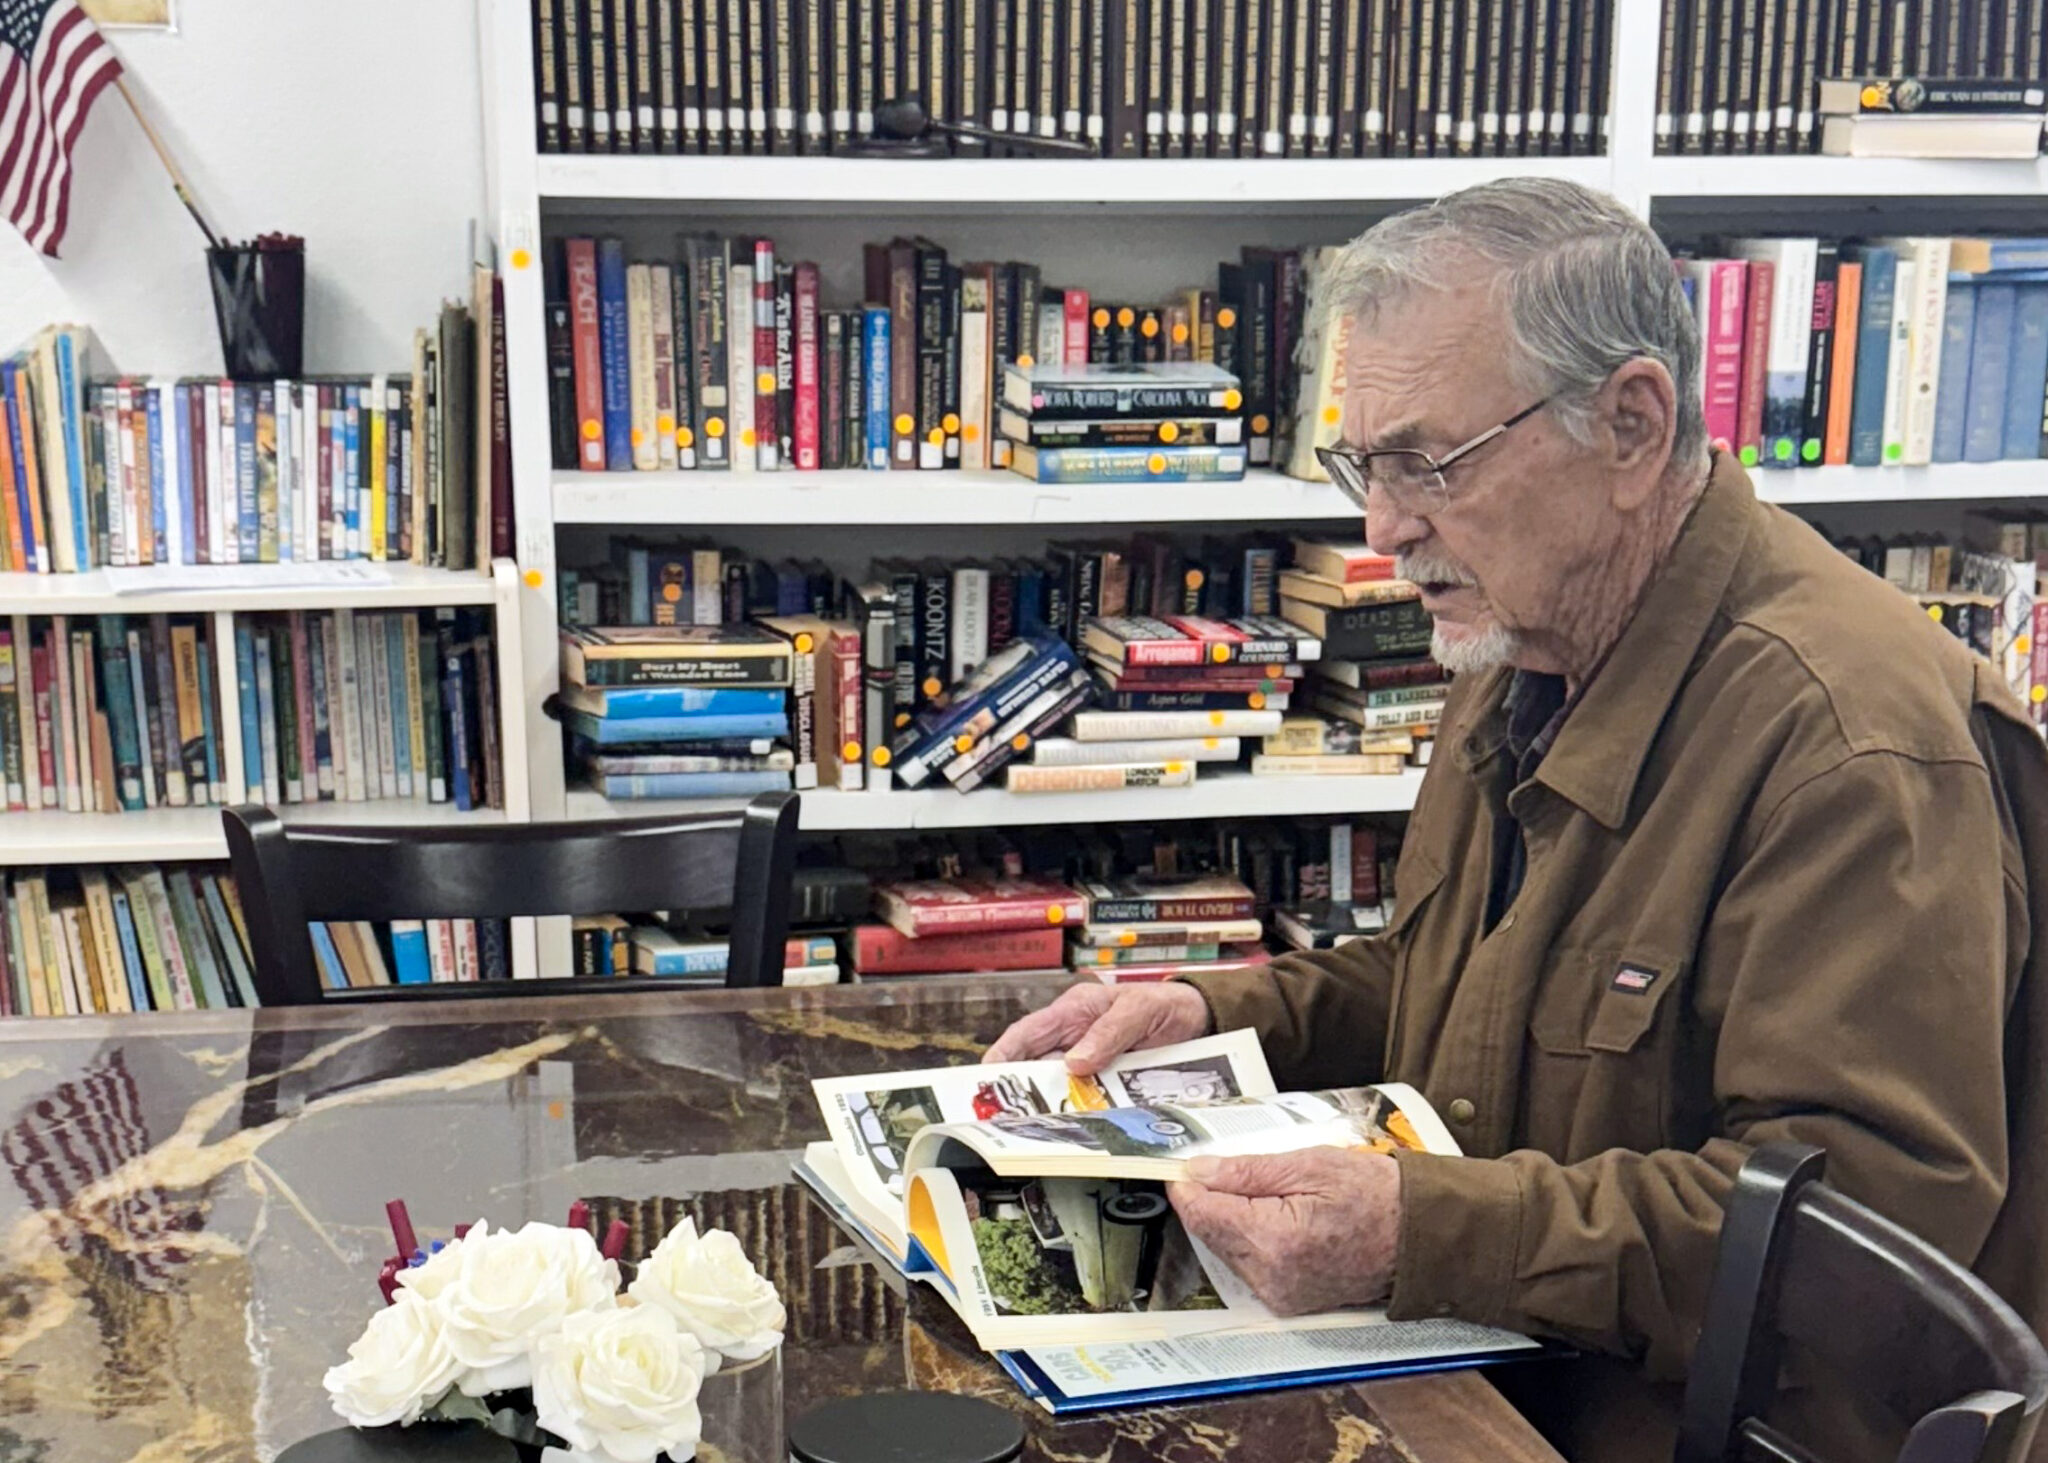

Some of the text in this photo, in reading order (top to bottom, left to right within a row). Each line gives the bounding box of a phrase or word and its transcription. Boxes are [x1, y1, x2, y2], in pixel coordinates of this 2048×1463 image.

[777, 328, 791, 351] for
[777, 351, 793, 390] Alibi
[925, 581, 946, 660] KOONTZ
[1134, 644, 1198, 667] Arrogance
[1241, 641, 1288, 653] BERNARD
[650, 670, 710, 680] Wounded
[677, 662, 698, 674] My
[700, 661, 740, 672] Heart
[798, 696, 812, 763] DISCLOSUR
[1125, 767, 1166, 777] LONDON
